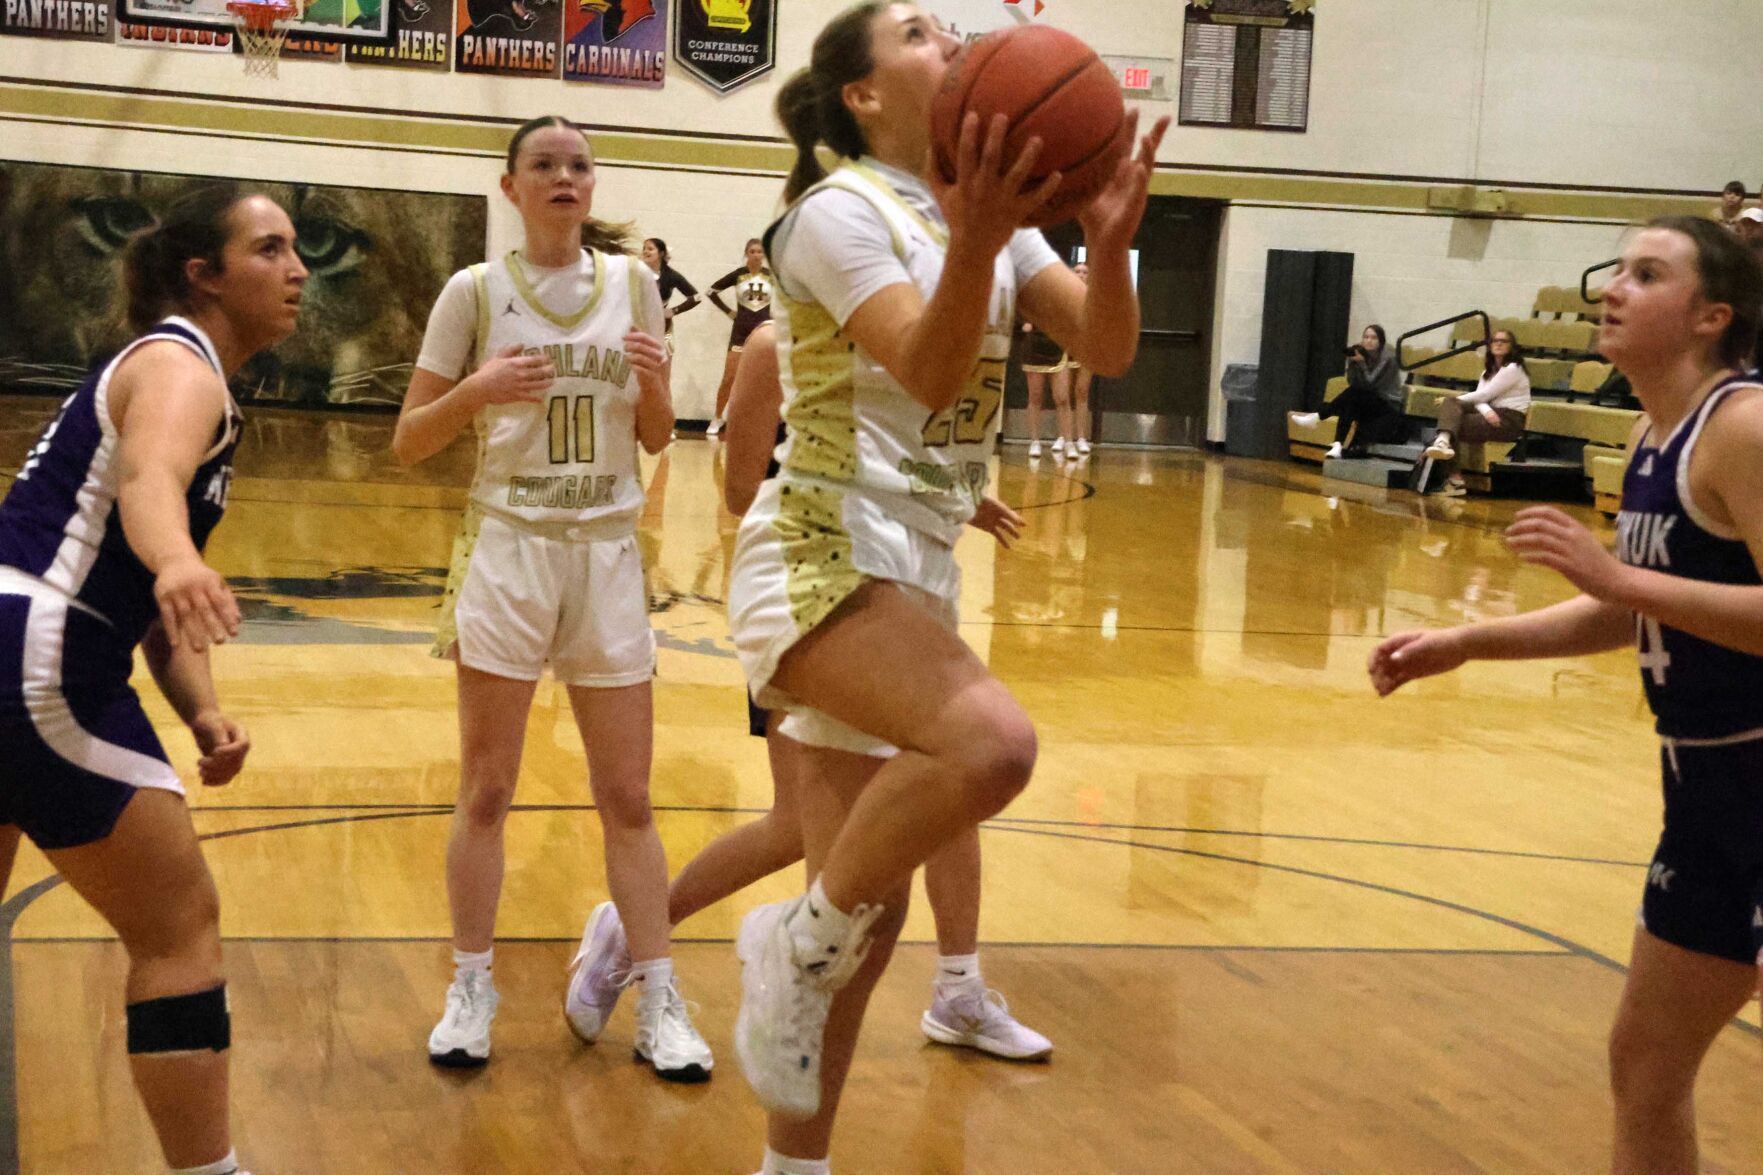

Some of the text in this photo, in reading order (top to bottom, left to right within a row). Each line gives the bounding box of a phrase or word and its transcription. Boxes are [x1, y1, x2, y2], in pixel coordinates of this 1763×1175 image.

[5, 0, 109, 34] PANTHERS
[463, 34, 556, 71] PANTHERS
[565, 43, 665, 80] CARDINALS
[688, 40, 759, 53] CONFERENCE
[691, 51, 755, 64] CHAMPIONS
[1125, 68, 1150, 88] EXIT
[547, 394, 595, 465] 11
